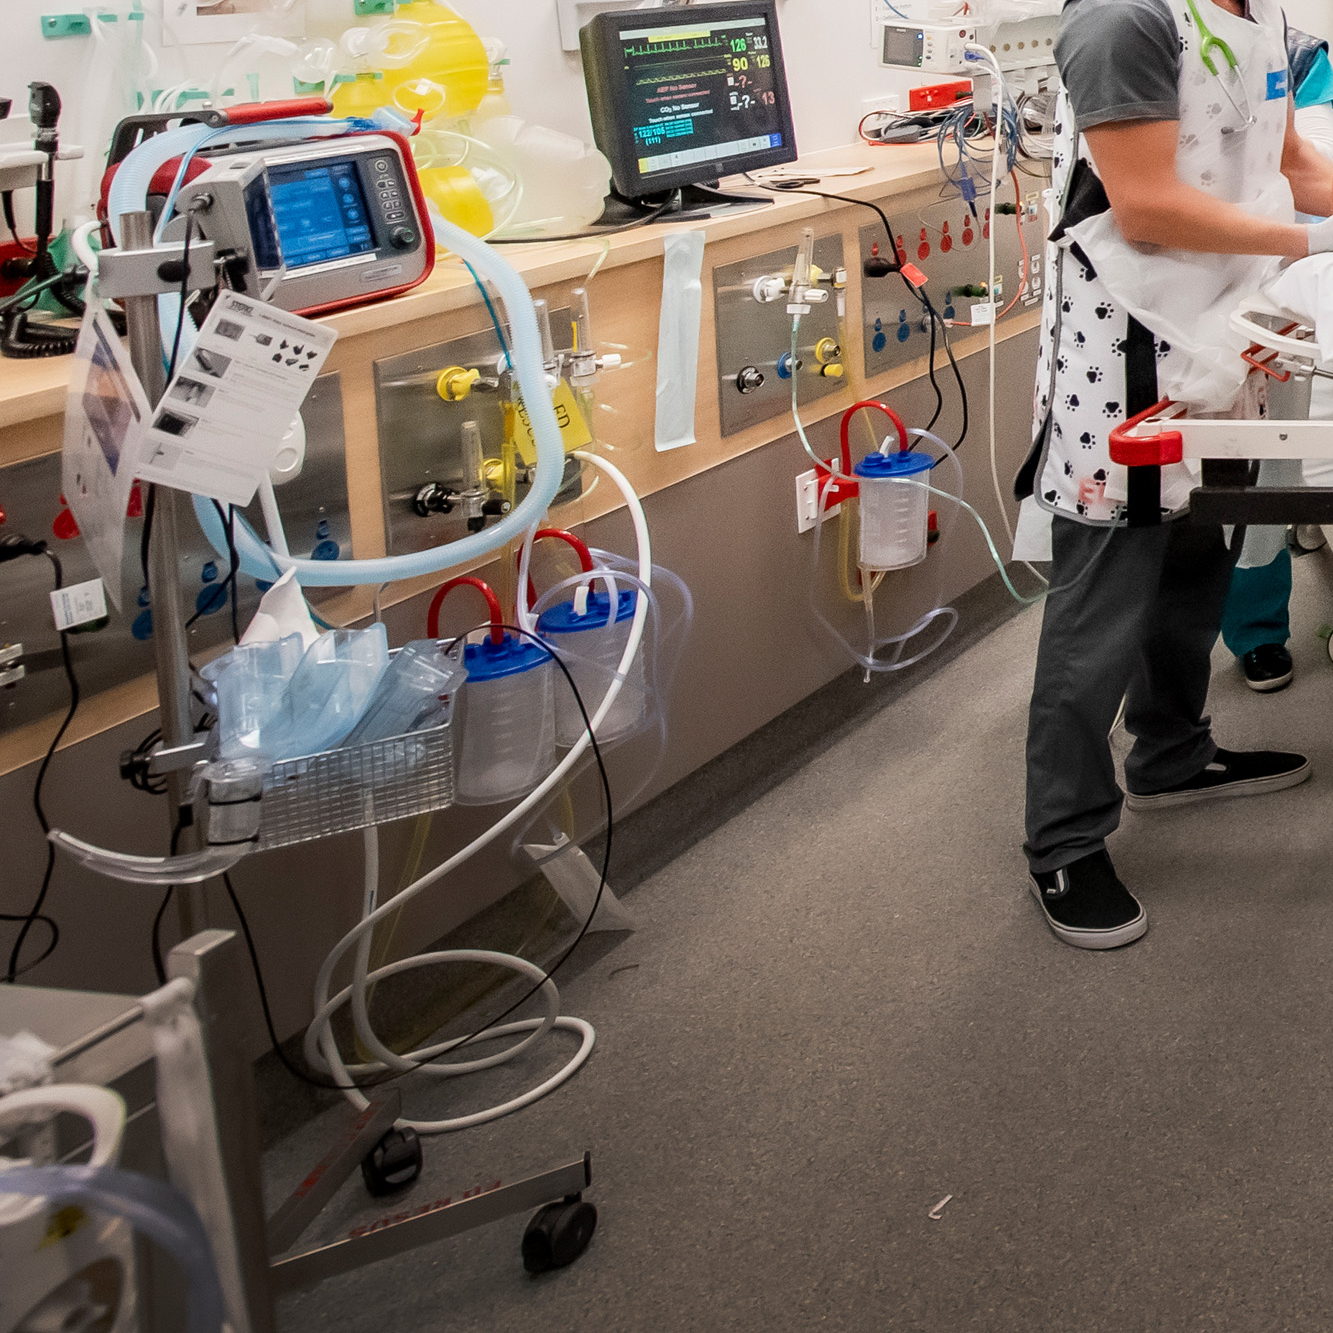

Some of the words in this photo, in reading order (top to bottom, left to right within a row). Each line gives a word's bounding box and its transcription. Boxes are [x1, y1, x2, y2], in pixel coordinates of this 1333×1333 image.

[729, 38, 747, 53] 126
[732, 56, 748, 71] 90
[761, 91, 776, 106] 13
